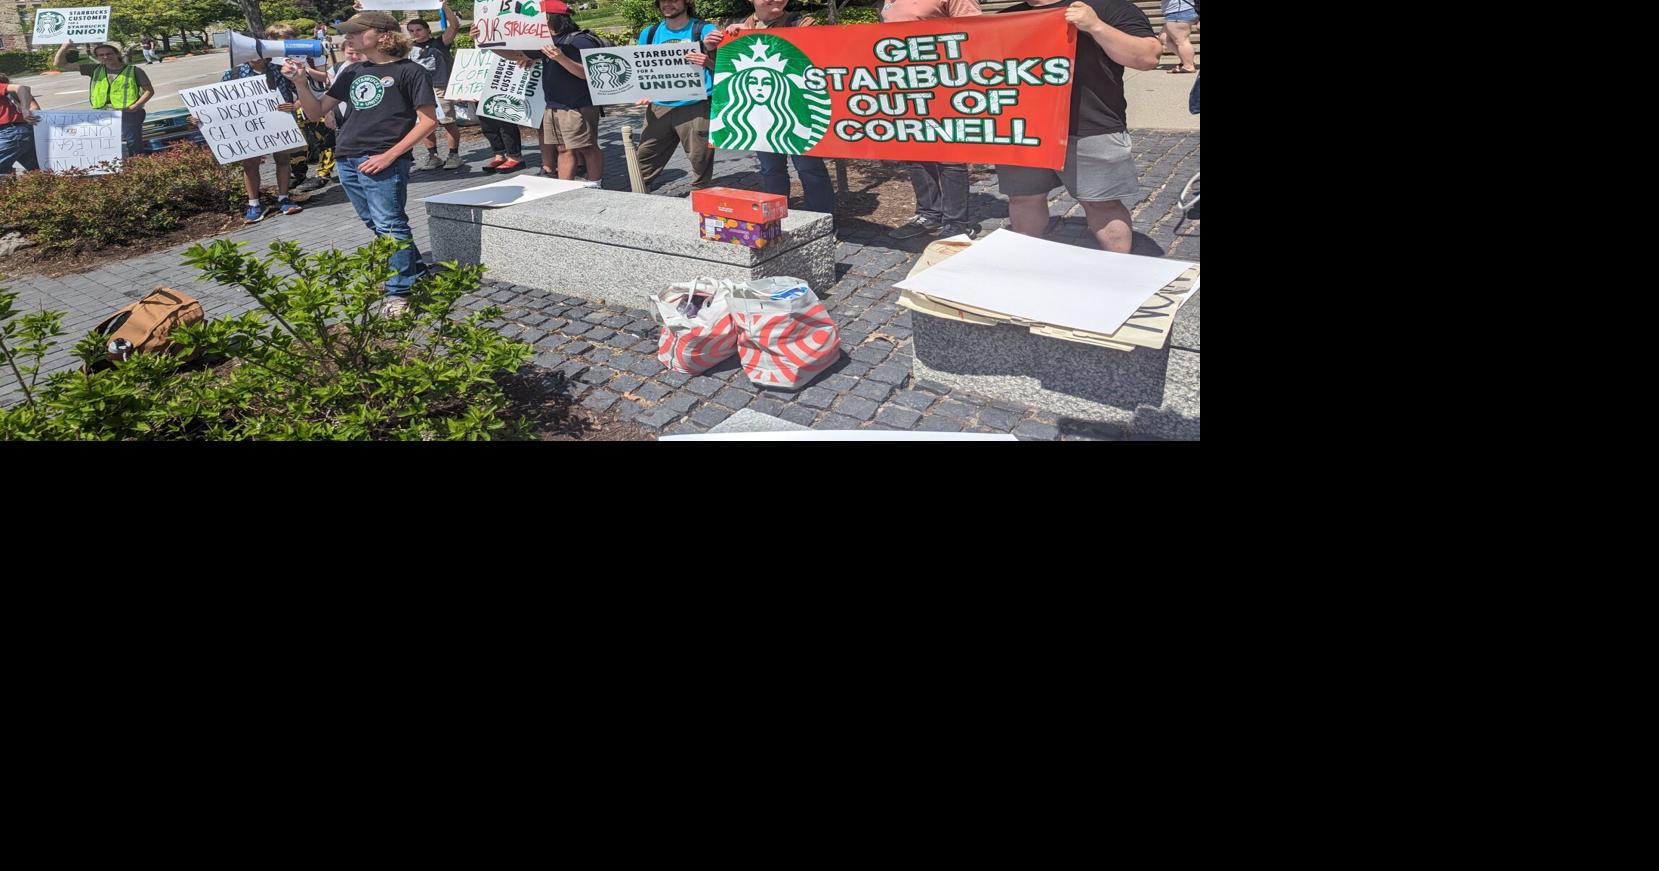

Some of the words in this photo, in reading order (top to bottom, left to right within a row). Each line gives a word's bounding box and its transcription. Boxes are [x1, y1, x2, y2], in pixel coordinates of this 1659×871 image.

[476, 18, 502, 44] OUR
[504, 20, 550, 38] STRUGGLE
[460, 50, 492, 68] UNI
[874, 32, 968, 63] GET
[490, 59, 507, 90] STARBUCK
[500, 60, 516, 92] CUSTOME
[635, 58, 695, 68] CUSTOME
[638, 72, 700, 80] STARBUCKS
[804, 58, 1070, 92] STARBUCKS
[224, 78, 270, 101] BUSTIN
[516, 66, 531, 95] STARBUC
[524, 62, 544, 97] UNION
[640, 80, 702, 90] UNION
[195, 109, 212, 124] IS
[217, 97, 280, 120] DISGUSTIN
[846, 91, 936, 117] OUT
[950, 88, 1018, 116] OF
[208, 124, 239, 142] GET
[244, 116, 266, 132] OFF
[834, 116, 1040, 147] CORNELL
[216, 141, 256, 160] OUR
[254, 128, 304, 150] CAMPUS
